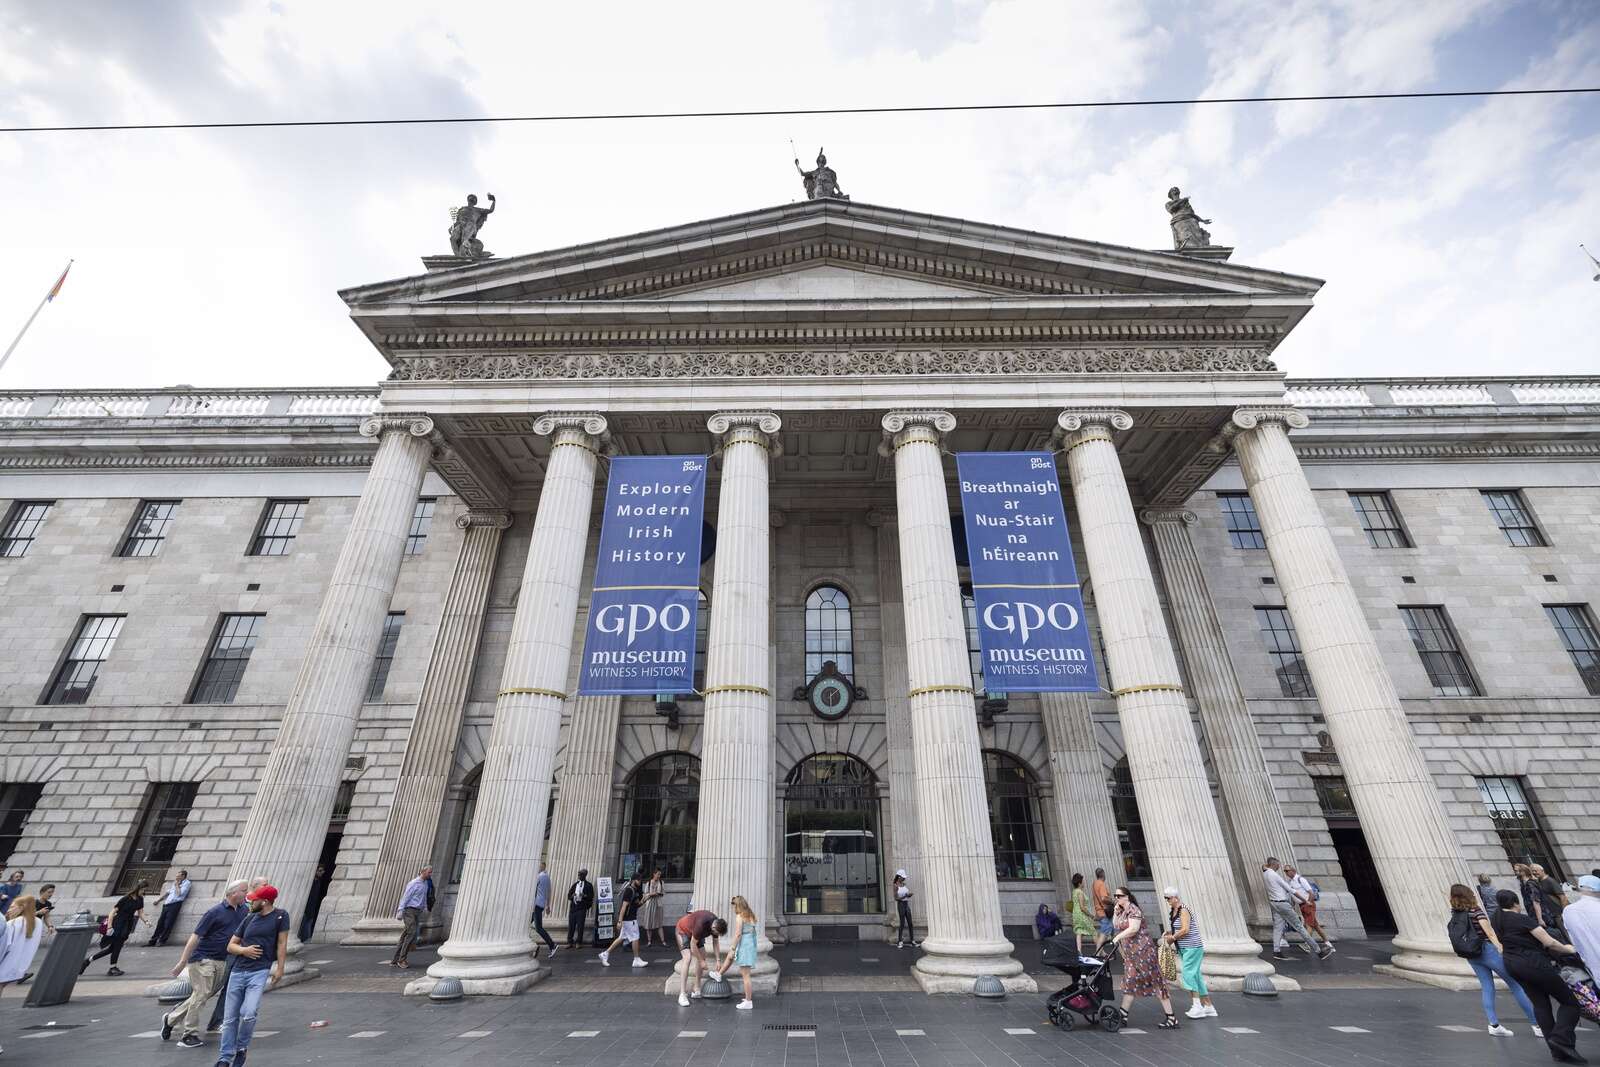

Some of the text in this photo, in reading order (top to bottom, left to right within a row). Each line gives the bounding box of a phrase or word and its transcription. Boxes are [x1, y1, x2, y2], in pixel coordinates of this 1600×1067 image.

[682, 464, 703, 472] post
[619, 482, 692, 497] Explore
[962, 479, 1058, 496] Breathnaigh
[616, 503, 690, 517] Modern
[1004, 500, 1020, 510] ar
[975, 513, 1055, 527] Nua-Stair
[628, 525, 673, 539] Irish
[1007, 533, 1028, 544] na
[611, 549, 686, 565] History
[982, 546, 1059, 561] hÉireann
[595, 603, 691, 647] GPO
[983, 602, 1079, 645] GPO
[591, 650, 687, 665] museum
[990, 648, 1087, 663] museum
[589, 666, 686, 678] WITNESS HISTORY
[990, 664, 1088, 675] WITNESS HISTORY
